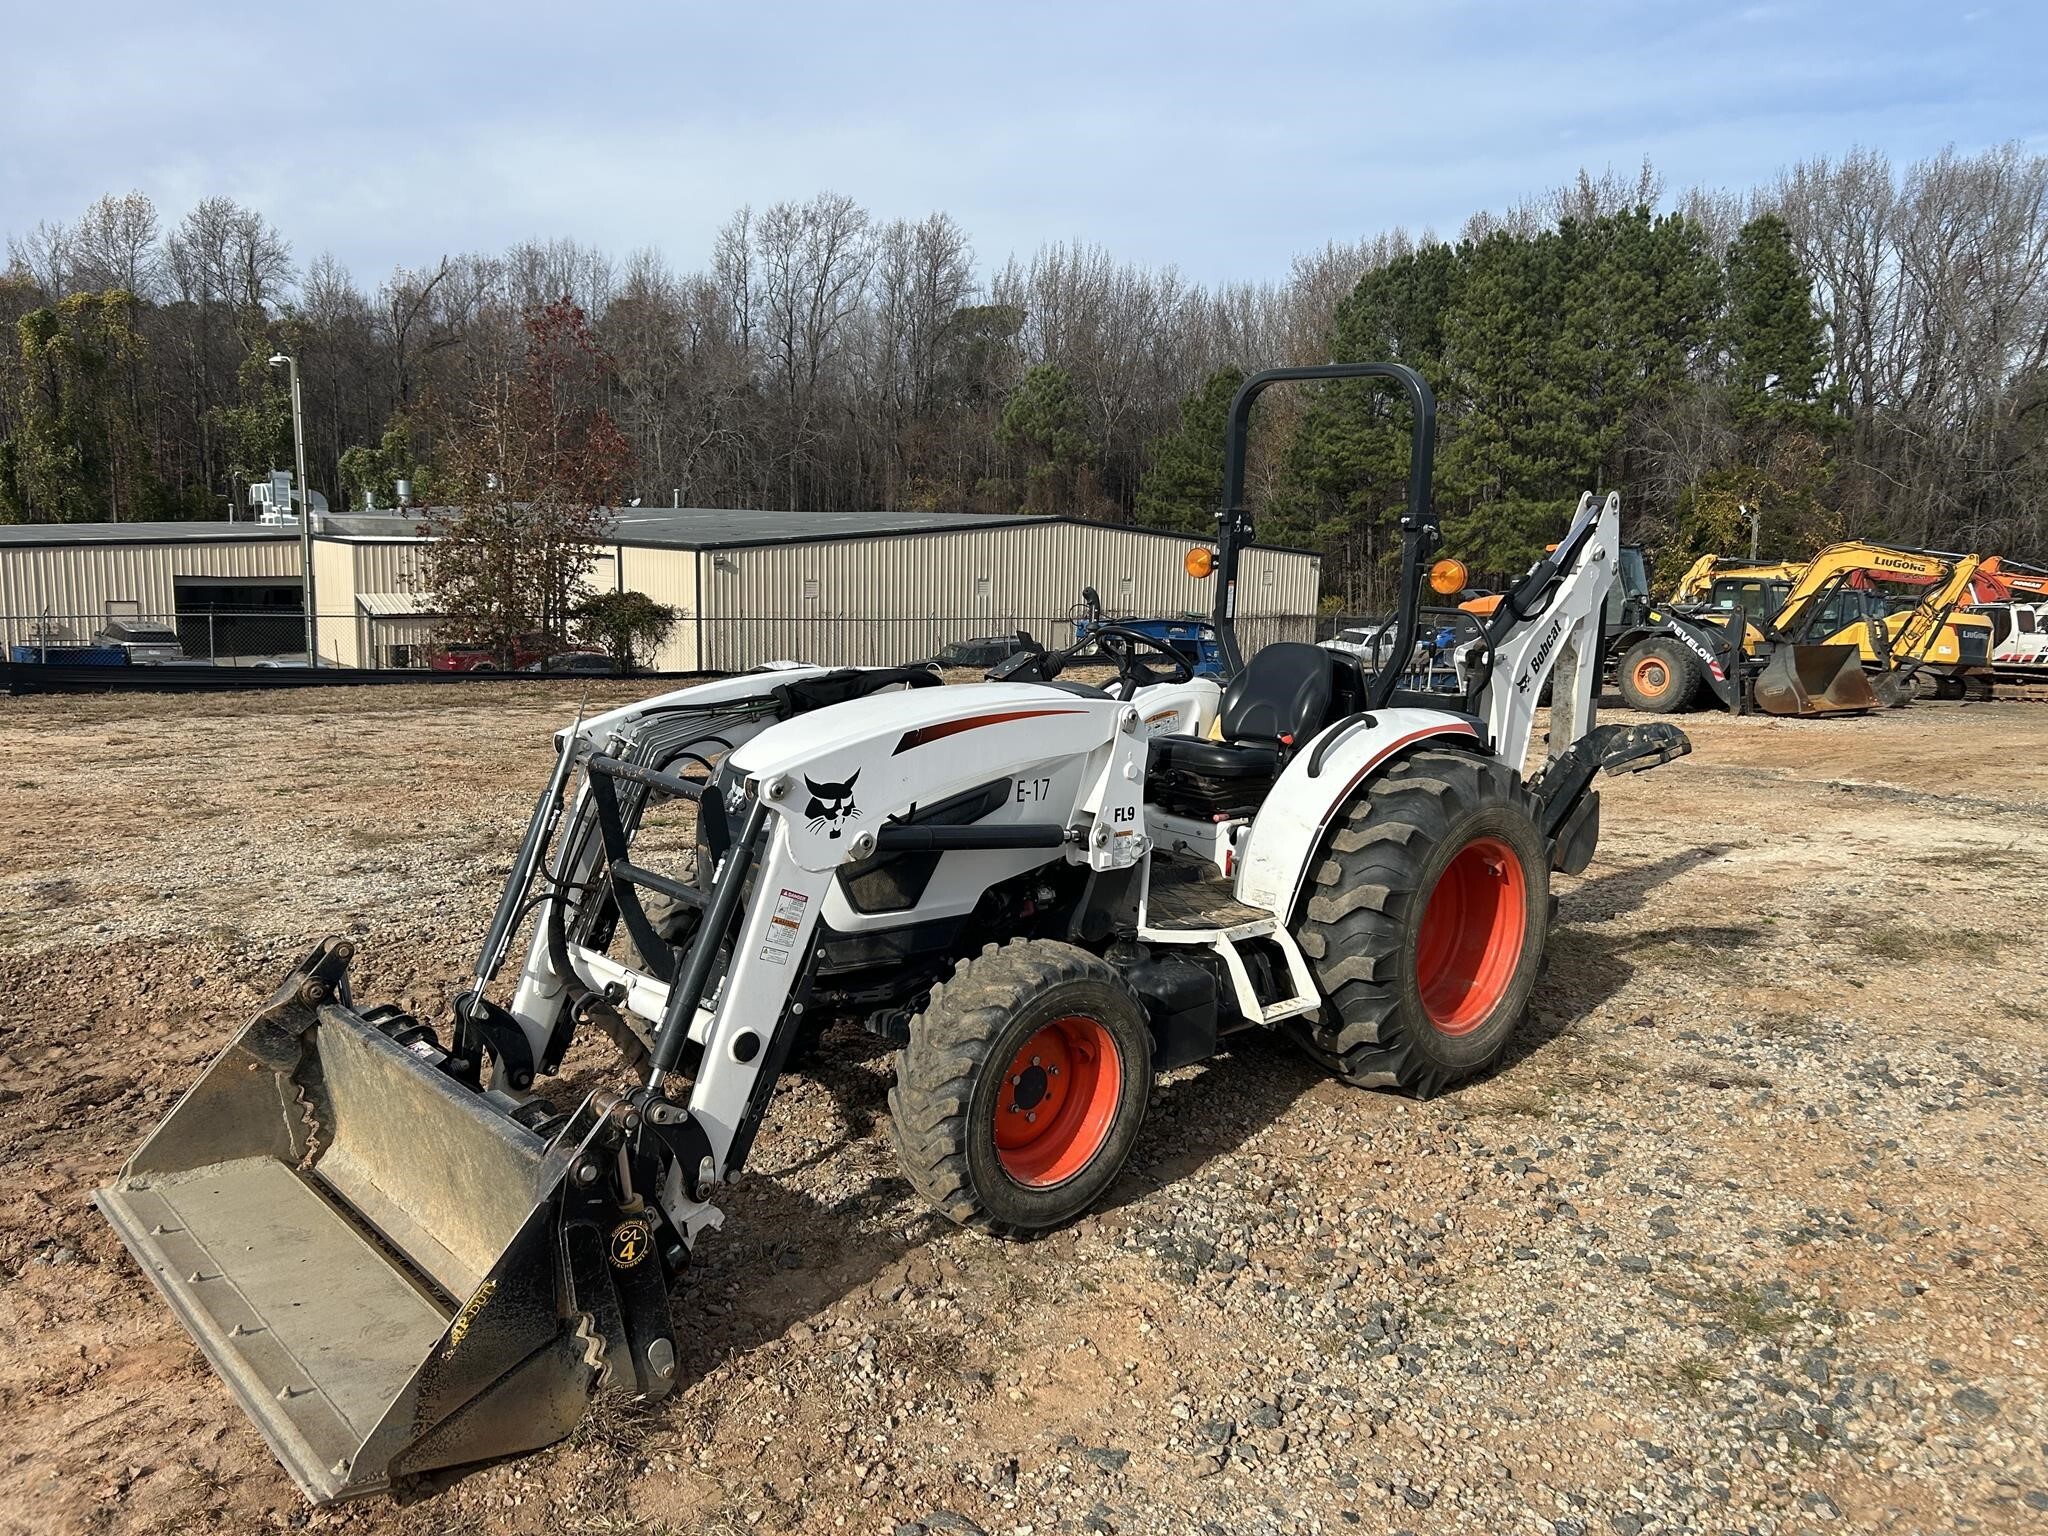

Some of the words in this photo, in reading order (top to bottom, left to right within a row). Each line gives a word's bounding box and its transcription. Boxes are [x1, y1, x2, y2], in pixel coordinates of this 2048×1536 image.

[1530, 619, 1562, 675] Bobcat
[1667, 620, 1714, 665] DEVELON
[1016, 778, 1051, 803] E-17
[1114, 806, 1135, 823] FL9
[620, 1241, 635, 1260] 4
